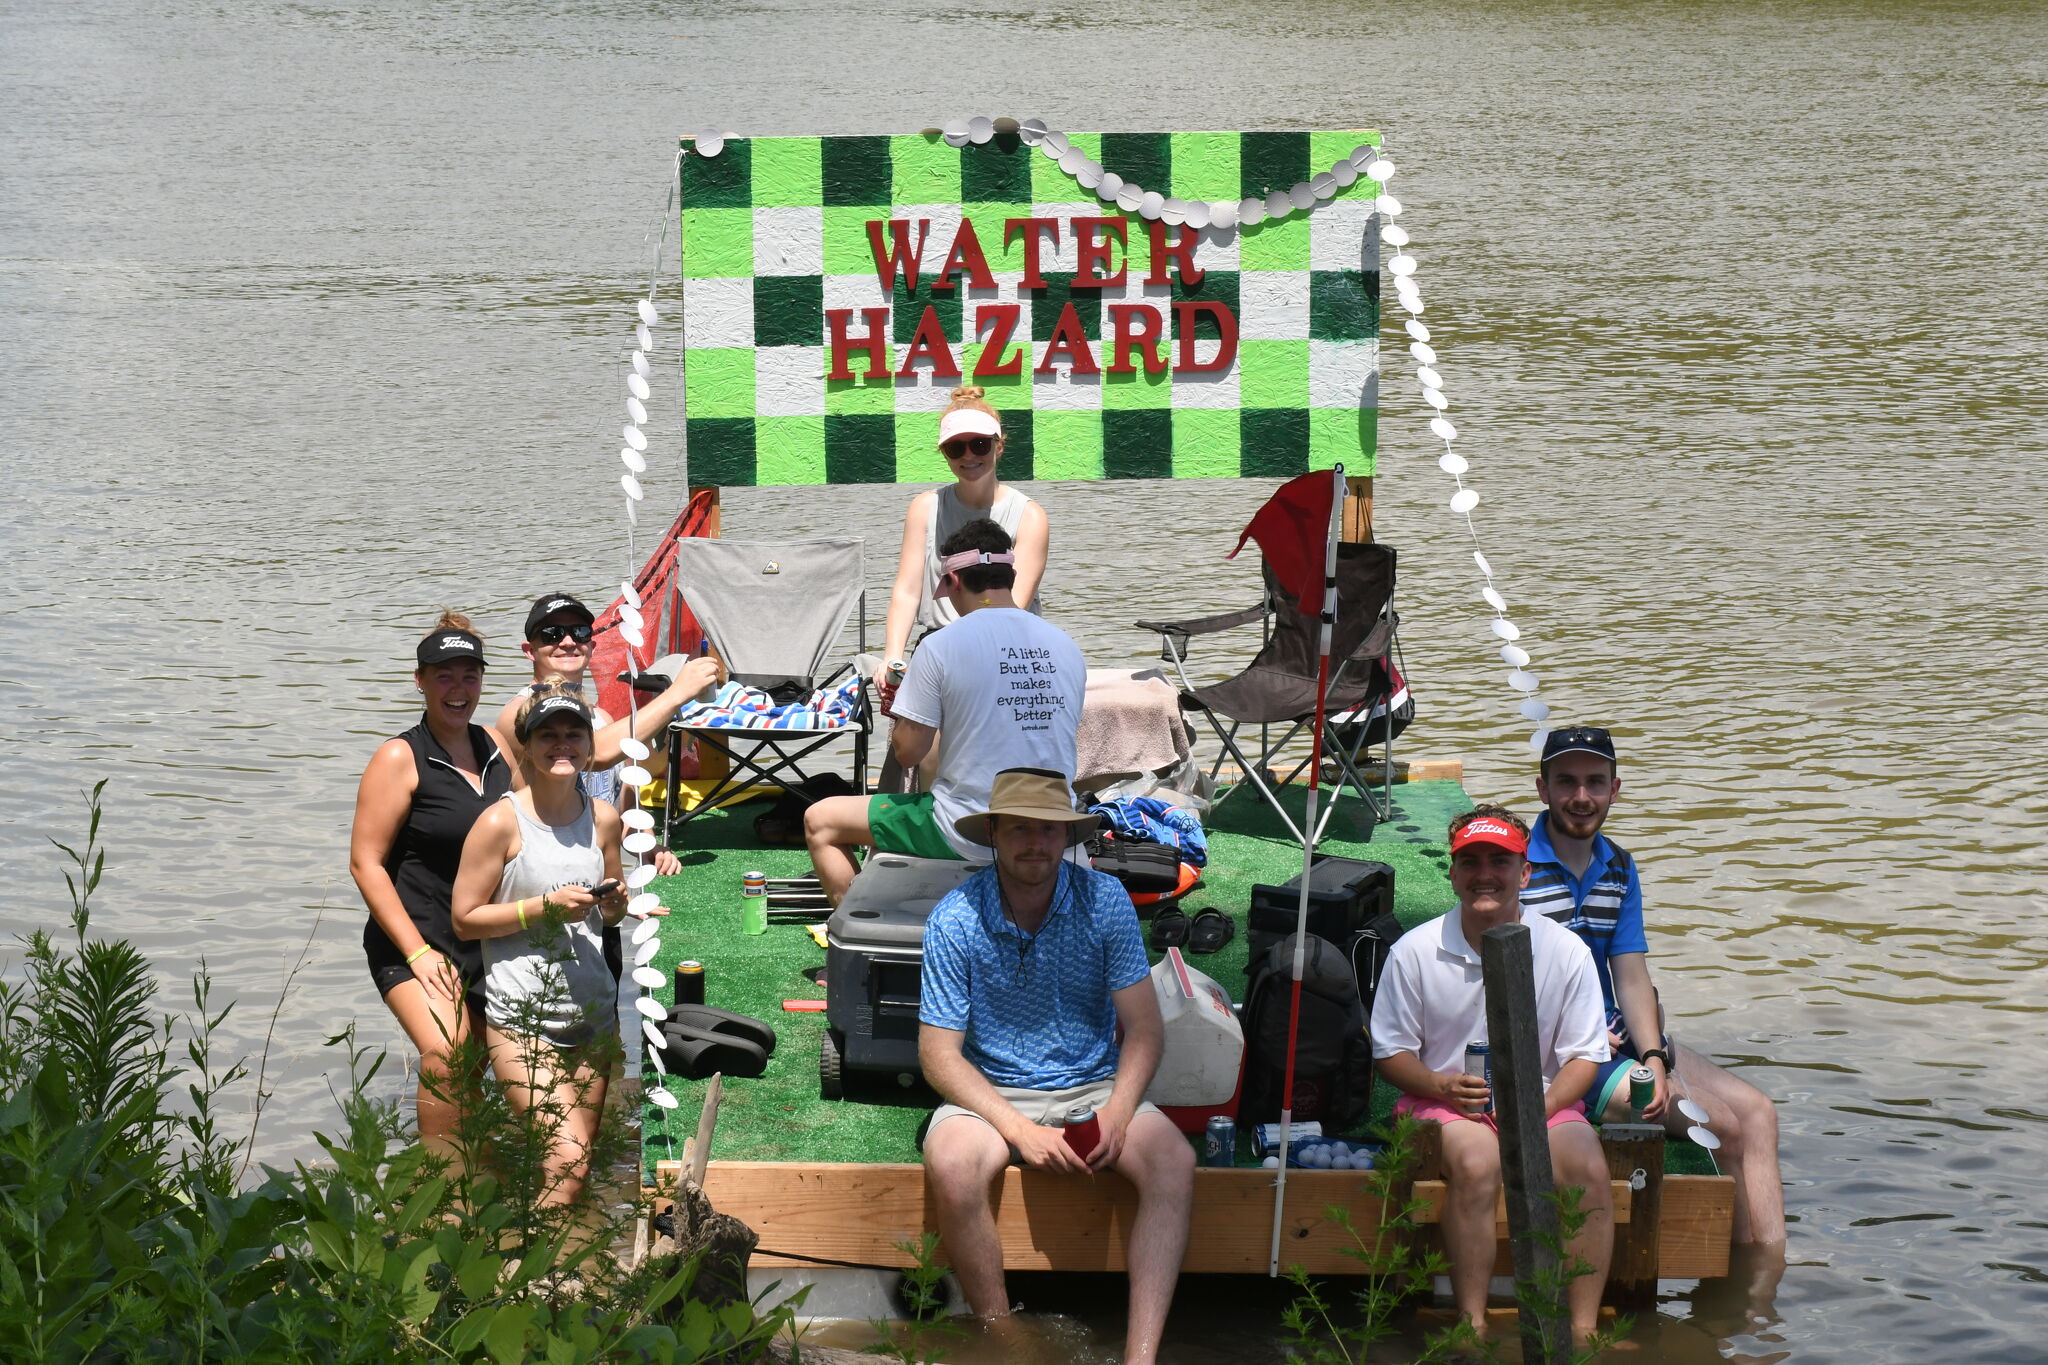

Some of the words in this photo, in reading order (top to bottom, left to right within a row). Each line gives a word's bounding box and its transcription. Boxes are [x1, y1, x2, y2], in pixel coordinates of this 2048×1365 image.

[866, 216, 1206, 292] WATER
[825, 301, 1238, 380] HAZARD
[1020, 648, 1050, 659] little
[1000, 662, 1028, 674] Butt
[1031, 662, 1056, 674] Rub
[1011, 678, 1051, 689] makes
[997, 693, 1065, 708] everything
[1014, 709, 1056, 721] better"
[1464, 820, 1508, 838] Titties
